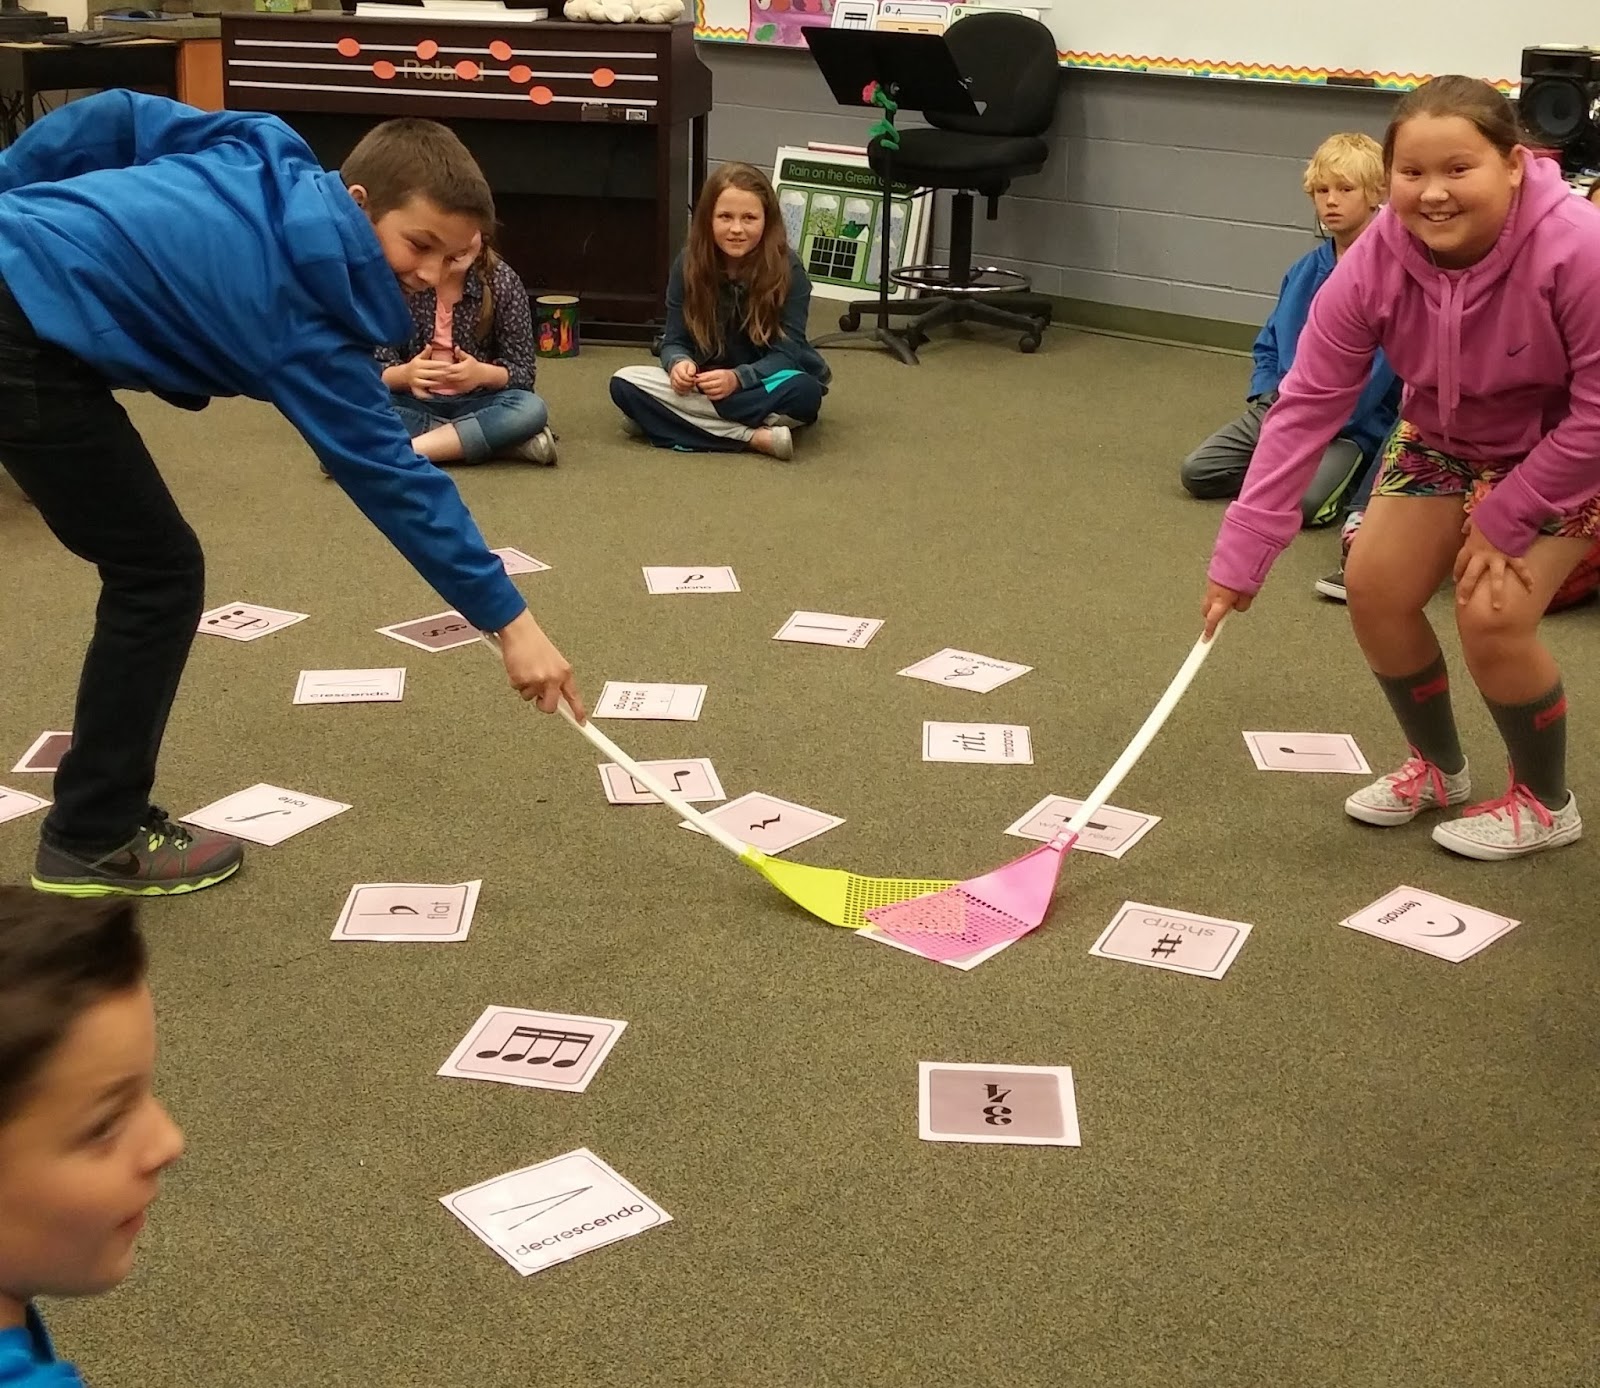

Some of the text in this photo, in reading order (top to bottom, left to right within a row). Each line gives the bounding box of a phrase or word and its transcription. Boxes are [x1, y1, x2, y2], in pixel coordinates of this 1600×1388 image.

[403, 59, 484, 81] Rolad
[788, 163, 810, 177] Rain
[811, 169, 825, 179] on
[827, 169, 843, 181] the
[844, 170, 876, 185] Green
[952, 732, 986, 752] rit.
[278, 796, 309, 808] forte
[427, 901, 451, 920] flat
[1377, 900, 1422, 925] fermata
[1142, 916, 1216, 937] sharp
[515, 1203, 644, 1256] decrescendo
